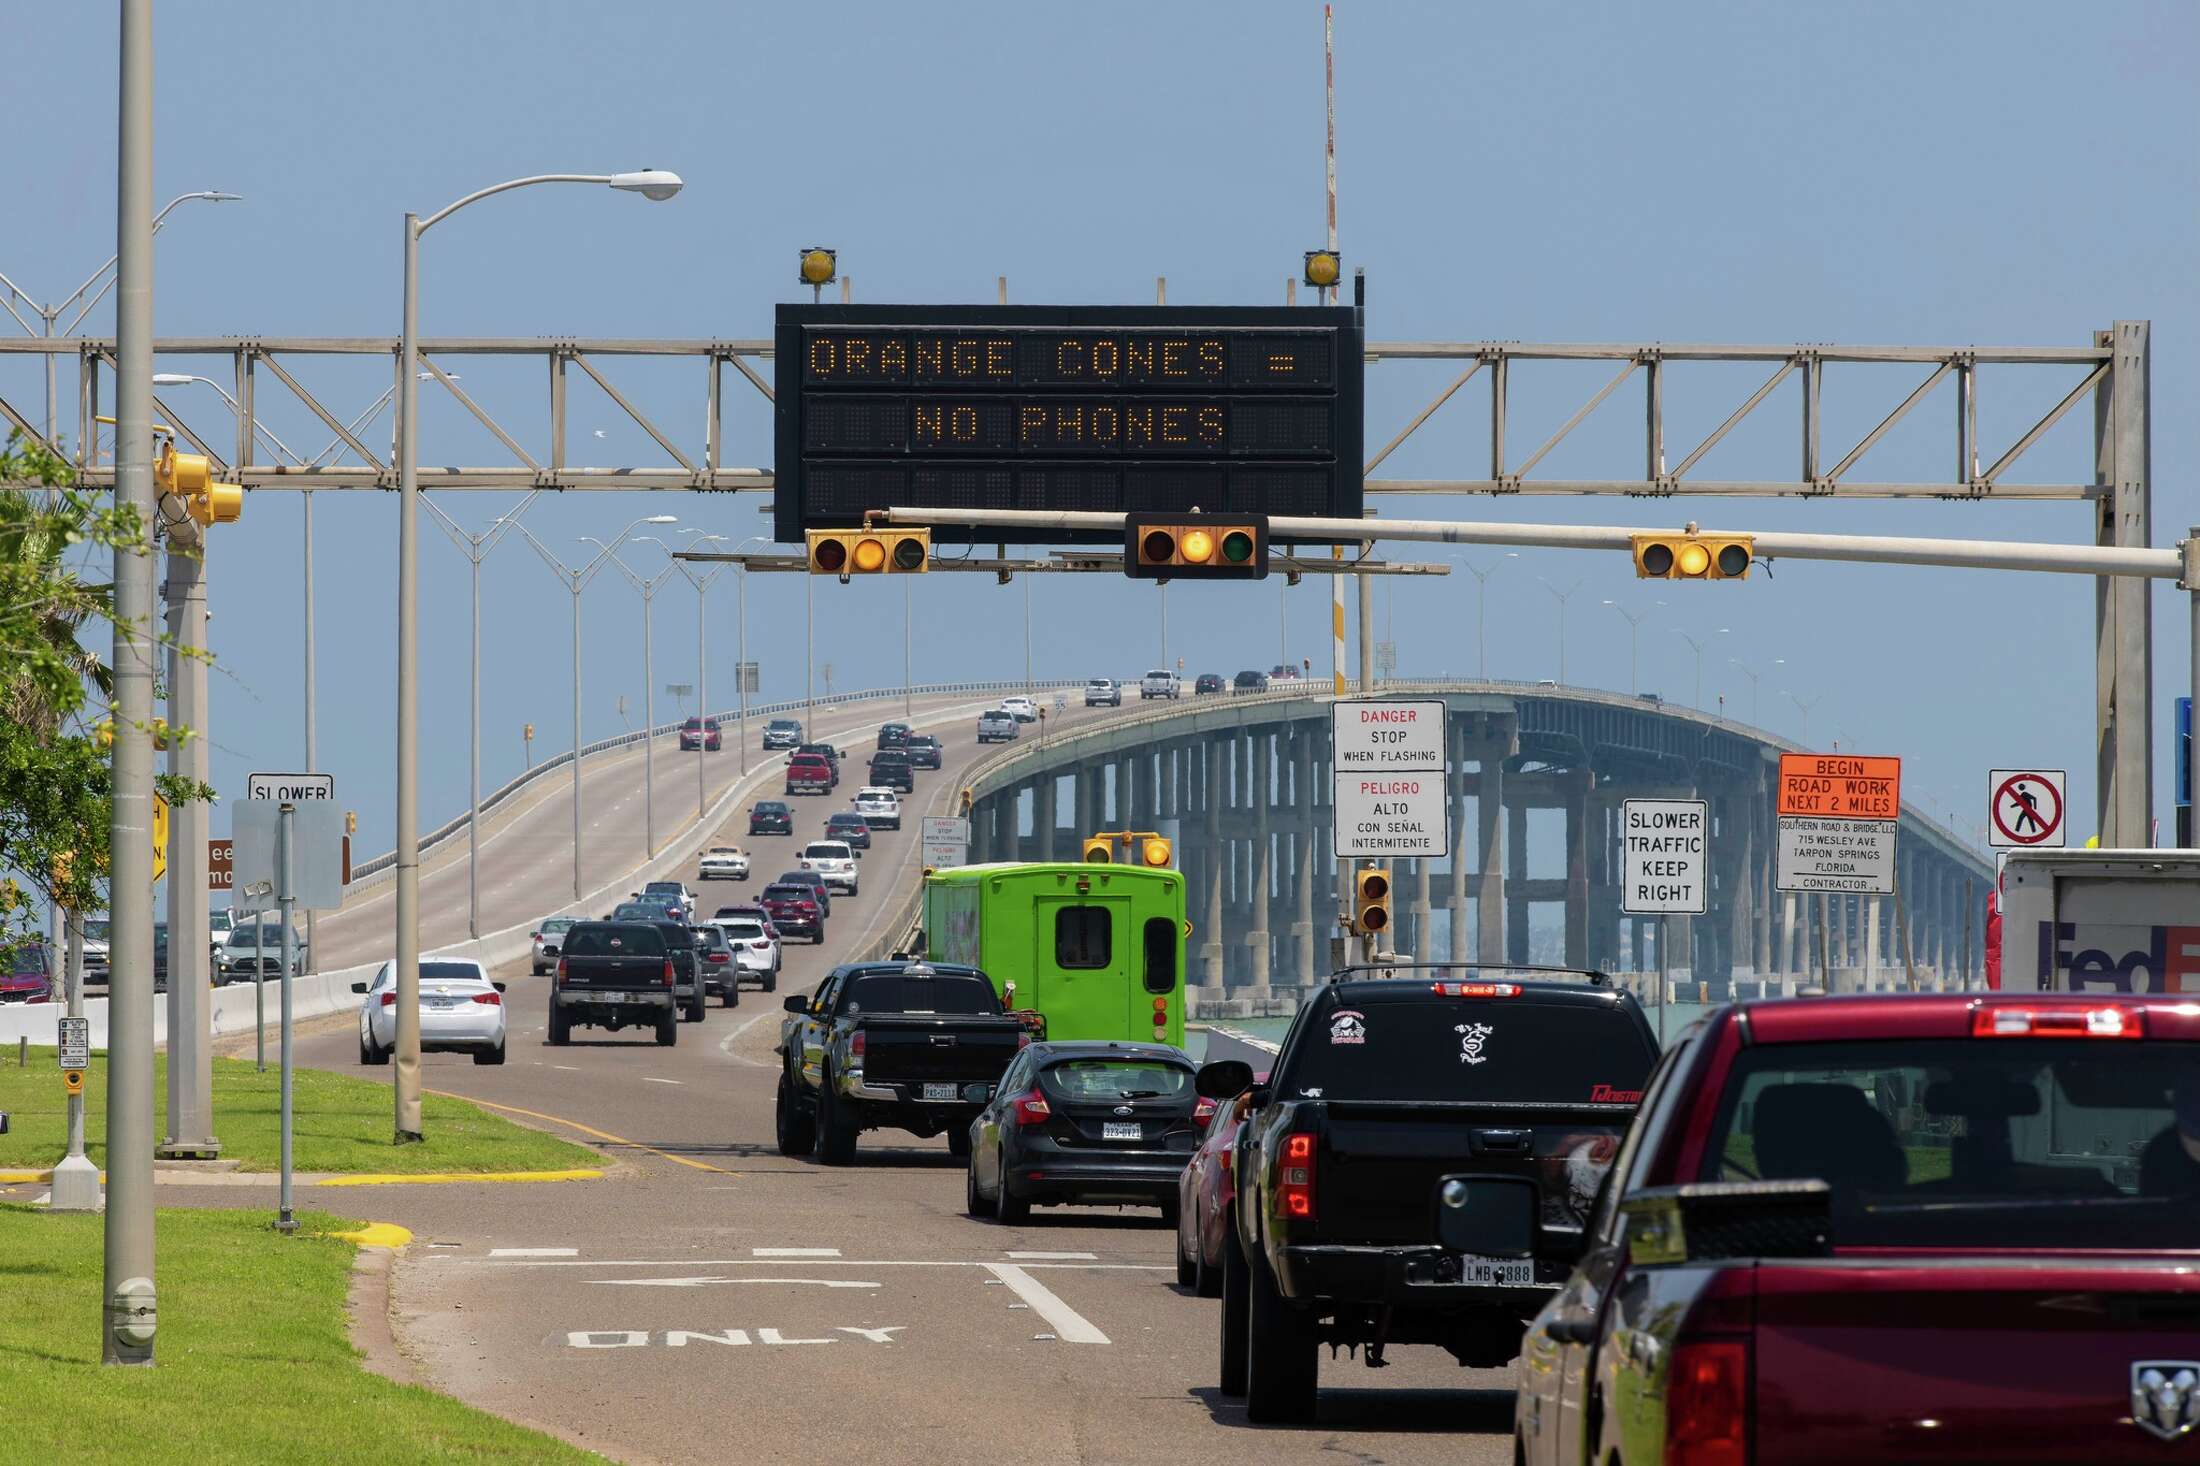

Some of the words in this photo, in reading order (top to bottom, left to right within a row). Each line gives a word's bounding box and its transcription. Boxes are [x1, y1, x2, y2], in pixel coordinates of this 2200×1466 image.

[809, 339, 1013, 376] ORANGE
[1056, 340, 1225, 376] CONES
[915, 405, 978, 441] NO
[1020, 406, 1225, 442] PHONES
[1361, 710, 1417, 723] DANGER
[1371, 731, 1407, 744] STOP
[1344, 751, 1374, 762] WHEN
[1381, 751, 1436, 762] FLASHING
[1816, 760, 1864, 775] BEGIN
[1361, 782, 1419, 794] PELIGRO
[1788, 778, 1831, 793] ROAD
[1845, 780, 1890, 795] WORK
[1373, 803, 1409, 815] ALTO
[1787, 795, 1821, 810] NEXT
[1831, 796, 1840, 811] 2
[1849, 798, 1890, 812] MILES
[1357, 823, 1380, 833] CON
[1387, 819, 1424, 833] SEÑAL
[1630, 812, 1700, 829] SLOWER
[1780, 819, 1818, 831] SOUTHERN
[1821, 822, 1841, 832] ROAD
[1843, 824, 1851, 832] &
[1882, 825, 1896, 834] LLC
[1351, 838, 1430, 849] INTERMITENTE
[1628, 836, 1701, 853] TRAFFIC
[1798, 835, 1814, 844] 715
[1816, 836, 1854, 846] WESLEY
[1857, 838, 1877, 847] AVE
[1794, 848, 1832, 858] TARPON
[1838, 850, 1880, 860] SPRINGS
[1642, 861, 1689, 877] KEEP
[1815, 863, 1856, 873] FLORIDA
[1803, 879, 1867, 889] CONTRACTOR
[1638, 884, 1692, 901] RIGHT
[567, 1325, 907, 1349] ONLY
